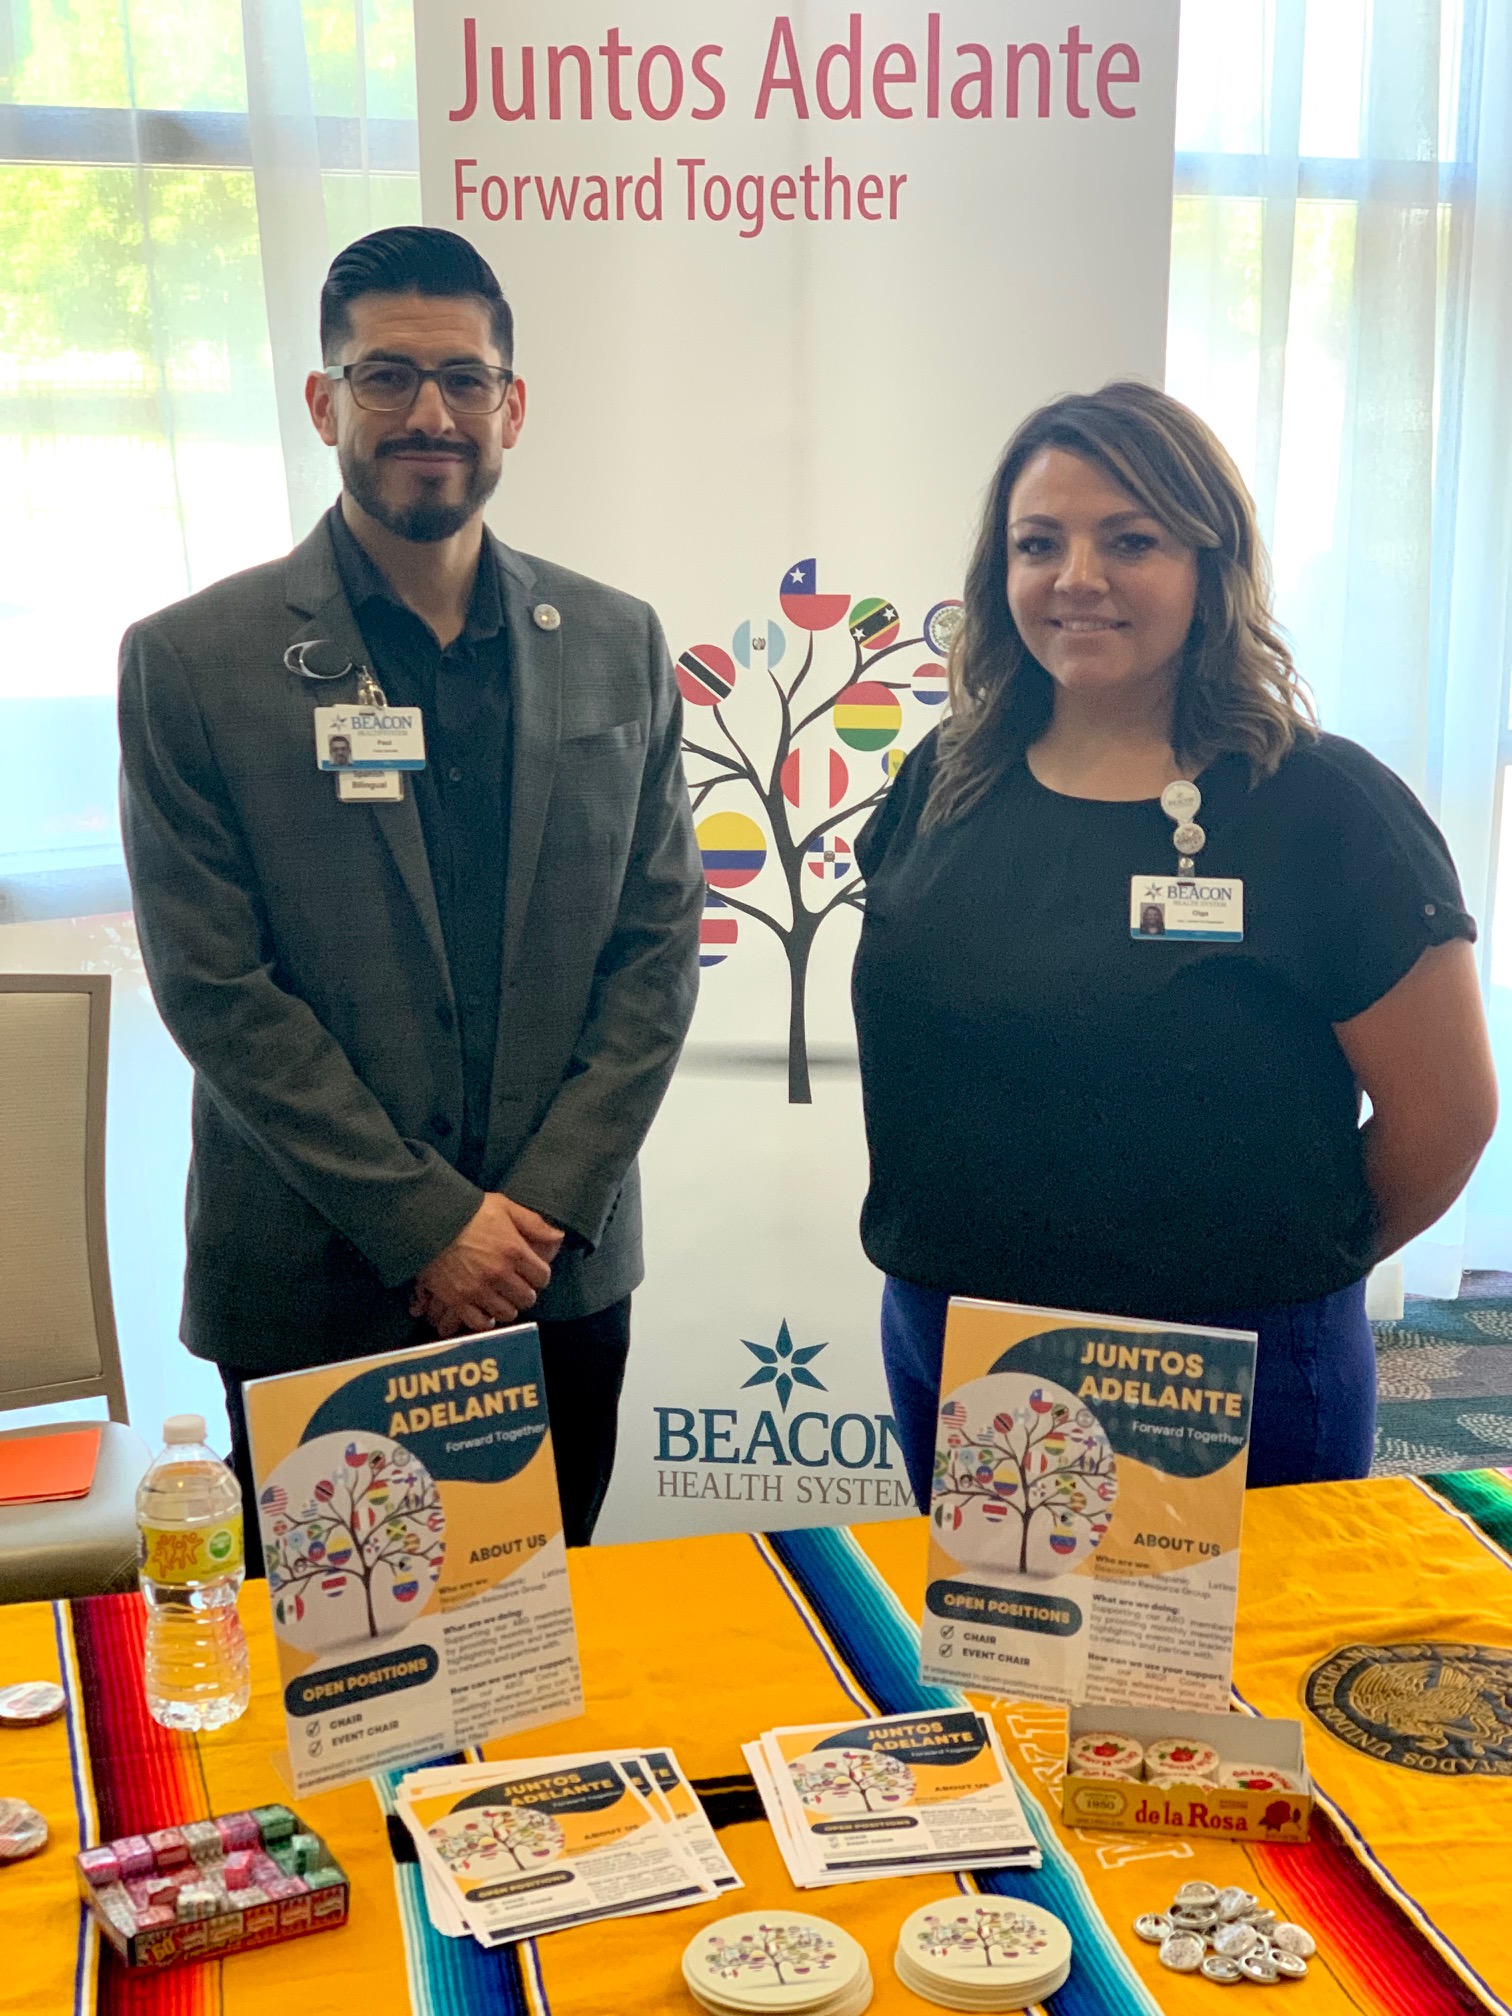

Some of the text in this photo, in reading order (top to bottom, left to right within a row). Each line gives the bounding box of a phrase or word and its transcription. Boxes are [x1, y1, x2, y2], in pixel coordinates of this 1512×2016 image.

[449, 13, 1141, 122] Juntos Adelante
[453, 156, 908, 239] Forward Together
[351, 716, 412, 729] BEACON
[352, 781, 387, 790] Bilingual
[1167, 886, 1232, 900] BEACON
[1080, 1340, 1204, 1379] JUNTOS
[382, 1356, 499, 1404] JUNTOS
[1078, 1374, 1242, 1417] ADELANTE
[387, 1382, 538, 1438] ADELANTE
[445, 1421, 546, 1453] Forward Together
[653, 1407, 902, 1469] BEACON
[1132, 1421, 1243, 1447] Forward Together
[657, 1470, 918, 1508] HEALTH SYSTEM
[469, 1533, 547, 1563] ABOUT US
[1133, 1532, 1220, 1556] ABOUT US
[943, 1593, 1070, 1624] OPEN POSITIONS
[1092, 1593, 1116, 1603] What
[443, 1622, 465, 1635] What
[468, 1620, 481, 1628] are
[963, 1632, 996, 1644] CHAIR
[962, 1647, 1030, 1666] EVENT CHAIR
[1144, 1662, 1159, 1670] use
[1162, 1666, 1183, 1676] your
[302, 1679, 344, 1702] OPEN
[346, 1657, 428, 1690] POSITIONS
[329, 1713, 362, 1730] CHAIR
[331, 1720, 399, 1746] EVENT CHAIR
[864, 1722, 944, 1740] JUNTOS
[870, 1731, 974, 1752] ADELANTE
[500, 1773, 582, 1797] JUNTOS
[507, 1778, 615, 1807] ADELANTE
[1135, 1800, 1248, 1831] de la Rosa
